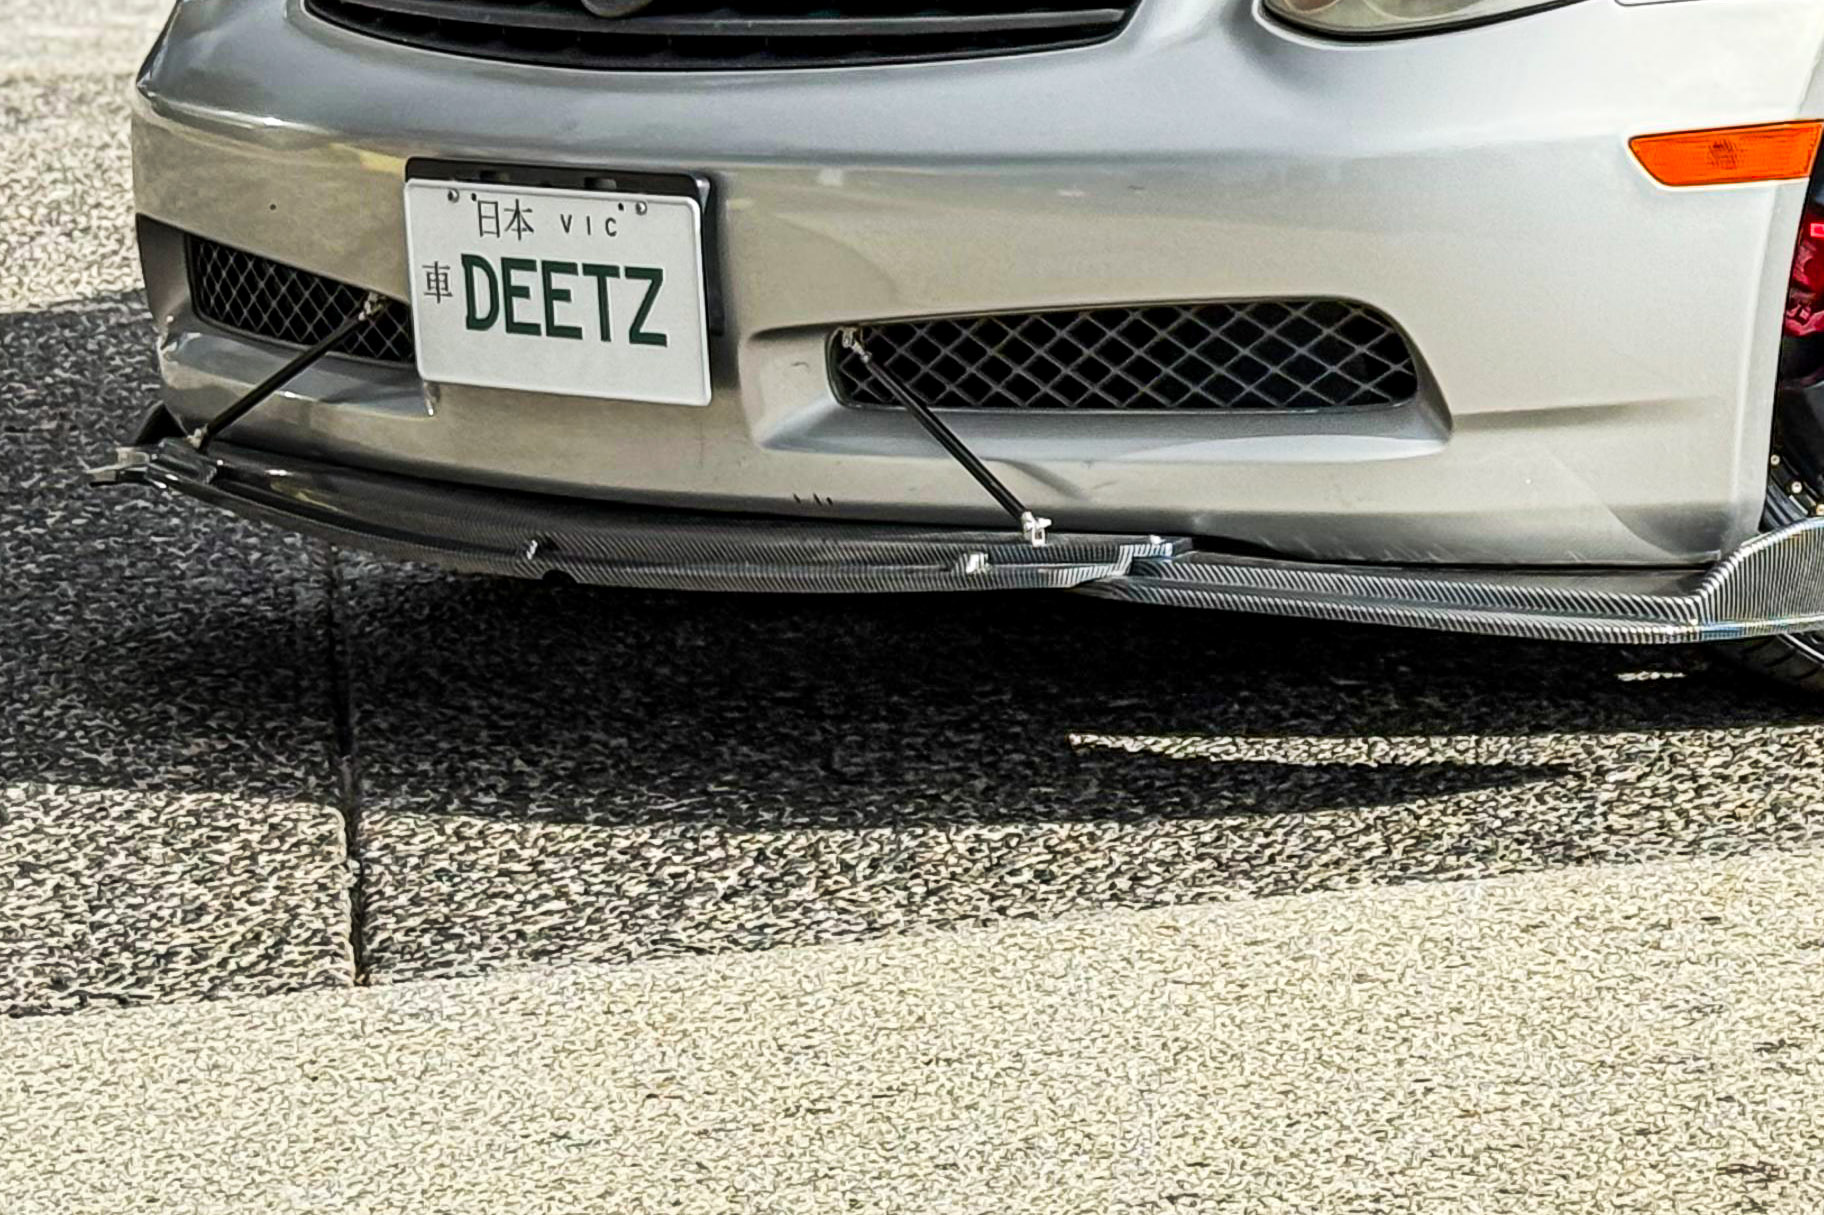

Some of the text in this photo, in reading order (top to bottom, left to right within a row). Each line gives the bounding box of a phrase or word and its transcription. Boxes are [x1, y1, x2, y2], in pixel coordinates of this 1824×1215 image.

[477, 198, 535, 241] 日本
[422, 261, 453, 304] 車
[461, 253, 668, 347] DEETZ
